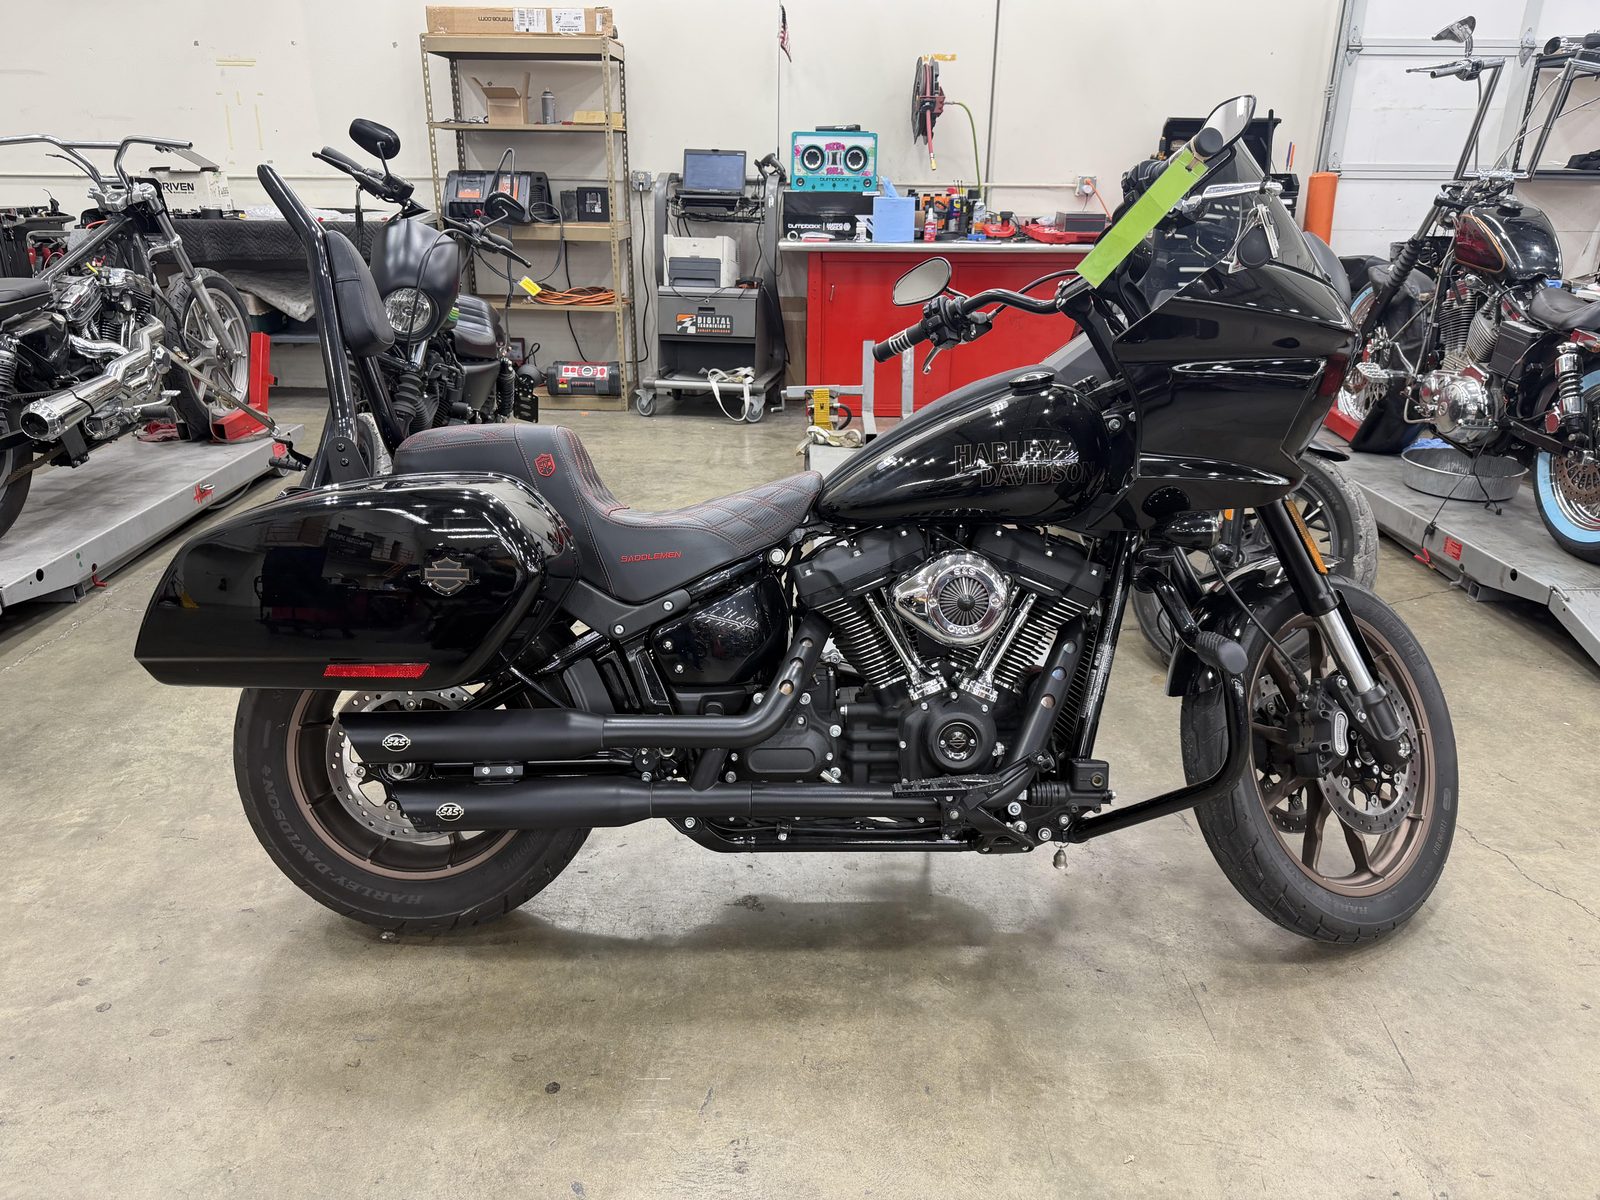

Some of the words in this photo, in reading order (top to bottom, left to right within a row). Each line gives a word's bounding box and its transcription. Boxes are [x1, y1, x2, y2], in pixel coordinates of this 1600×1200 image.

[697, 316, 731, 324] DIGITAL
[620, 551, 682, 563] SADDLEMEN
[953, 566, 977, 576] S&S
[946, 624, 980, 636] CYCLE
